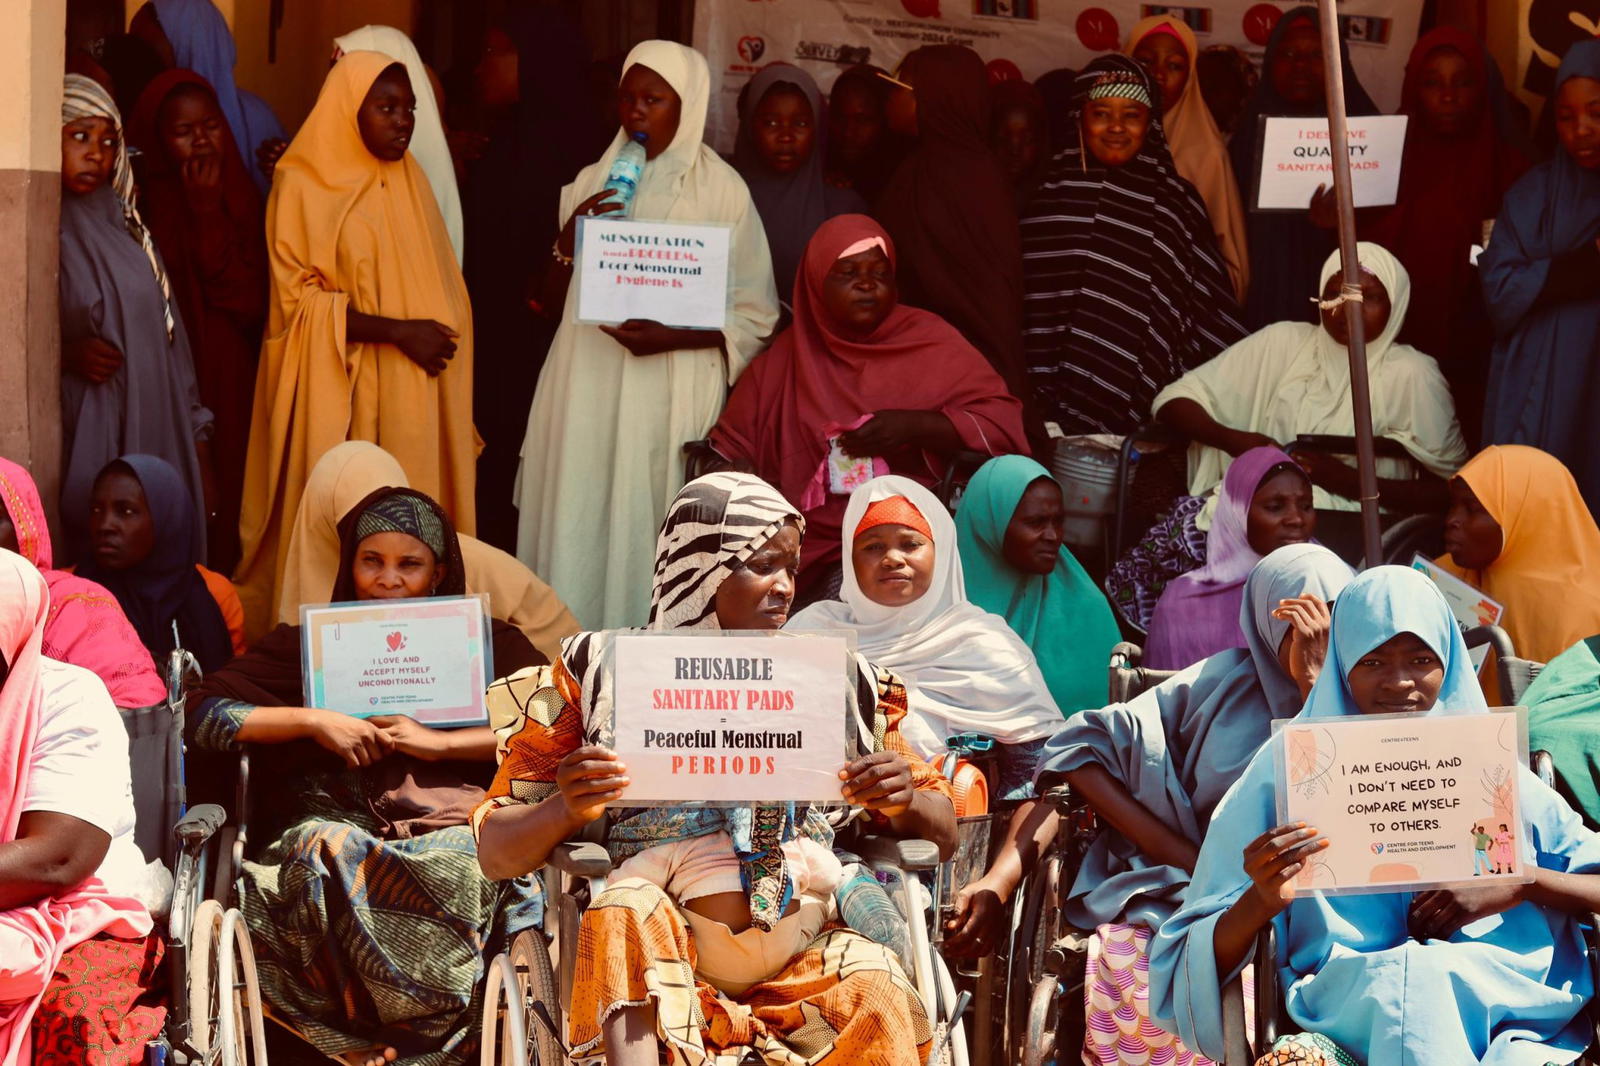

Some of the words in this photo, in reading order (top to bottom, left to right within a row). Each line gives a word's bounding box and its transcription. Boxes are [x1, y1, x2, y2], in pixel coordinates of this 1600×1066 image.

[1306, 129, 1367, 140] DESVE
[1293, 145, 1368, 158] QUATY
[1277, 162, 1336, 172] SANITAR
[599, 260, 629, 271] Poor
[633, 263, 702, 276] Menstrual
[616, 274, 670, 288] Hygiene
[378, 656, 400, 665] LOVE
[402, 655, 421, 664] AND
[362, 668, 396, 677] ACCEPT
[398, 666, 432, 675] MYSELF
[674, 656, 773, 681] REUSABLE
[358, 676, 437, 688] UNCONDITIONALLY
[652, 688, 741, 711] SANITARY
[746, 689, 795, 711] PADS
[643, 729, 717, 749] Peaceful
[721, 729, 803, 749] Menstrual
[671, 755, 775, 776] PERIODS
[1341, 764, 1346, 776] I
[1350, 764, 1370, 776] AM
[1374, 759, 1431, 774] ENOUGH,
[1435, 756, 1462, 769] AND
[1349, 783, 1354, 796] I
[1357, 780, 1396, 794] DON'T
[1400, 778, 1436, 792] NEED
[1440, 777, 1457, 789] TO
[1347, 800, 1408, 816] COMPARE
[1412, 797, 1461, 813] MYSELF
[1368, 822, 1386, 834] TO
[1390, 819, 1442, 832] OTHERS.
[1420, 844, 1456, 852] DEVELOPMENT
